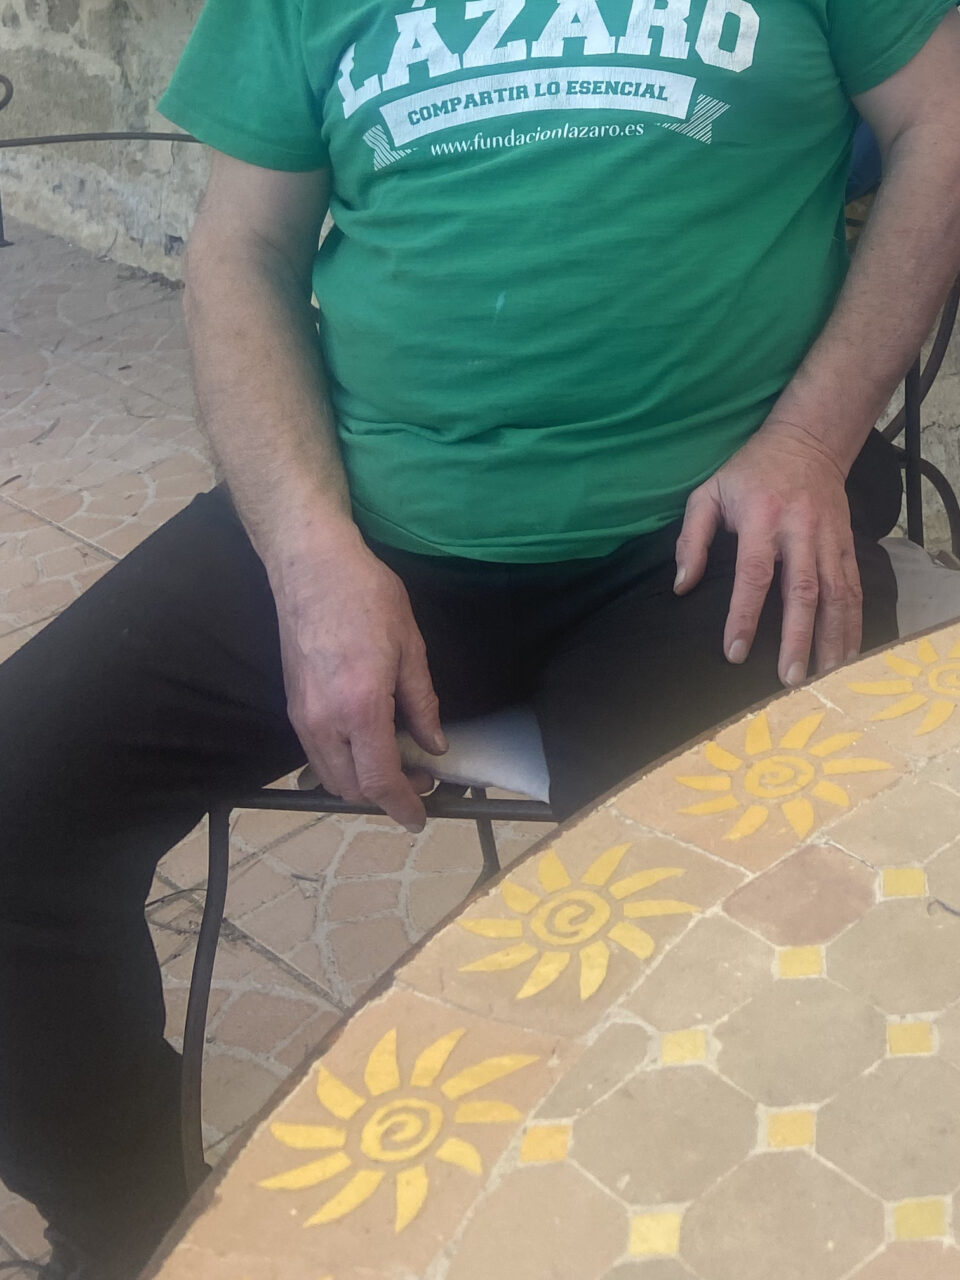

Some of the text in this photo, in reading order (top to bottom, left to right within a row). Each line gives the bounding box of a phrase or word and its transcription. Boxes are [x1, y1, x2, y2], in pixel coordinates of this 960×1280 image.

[407, 80, 668, 125] COMPARTIR LO ESENCIAL
[430, 121, 645, 157] www.fundacionlazaro.es
